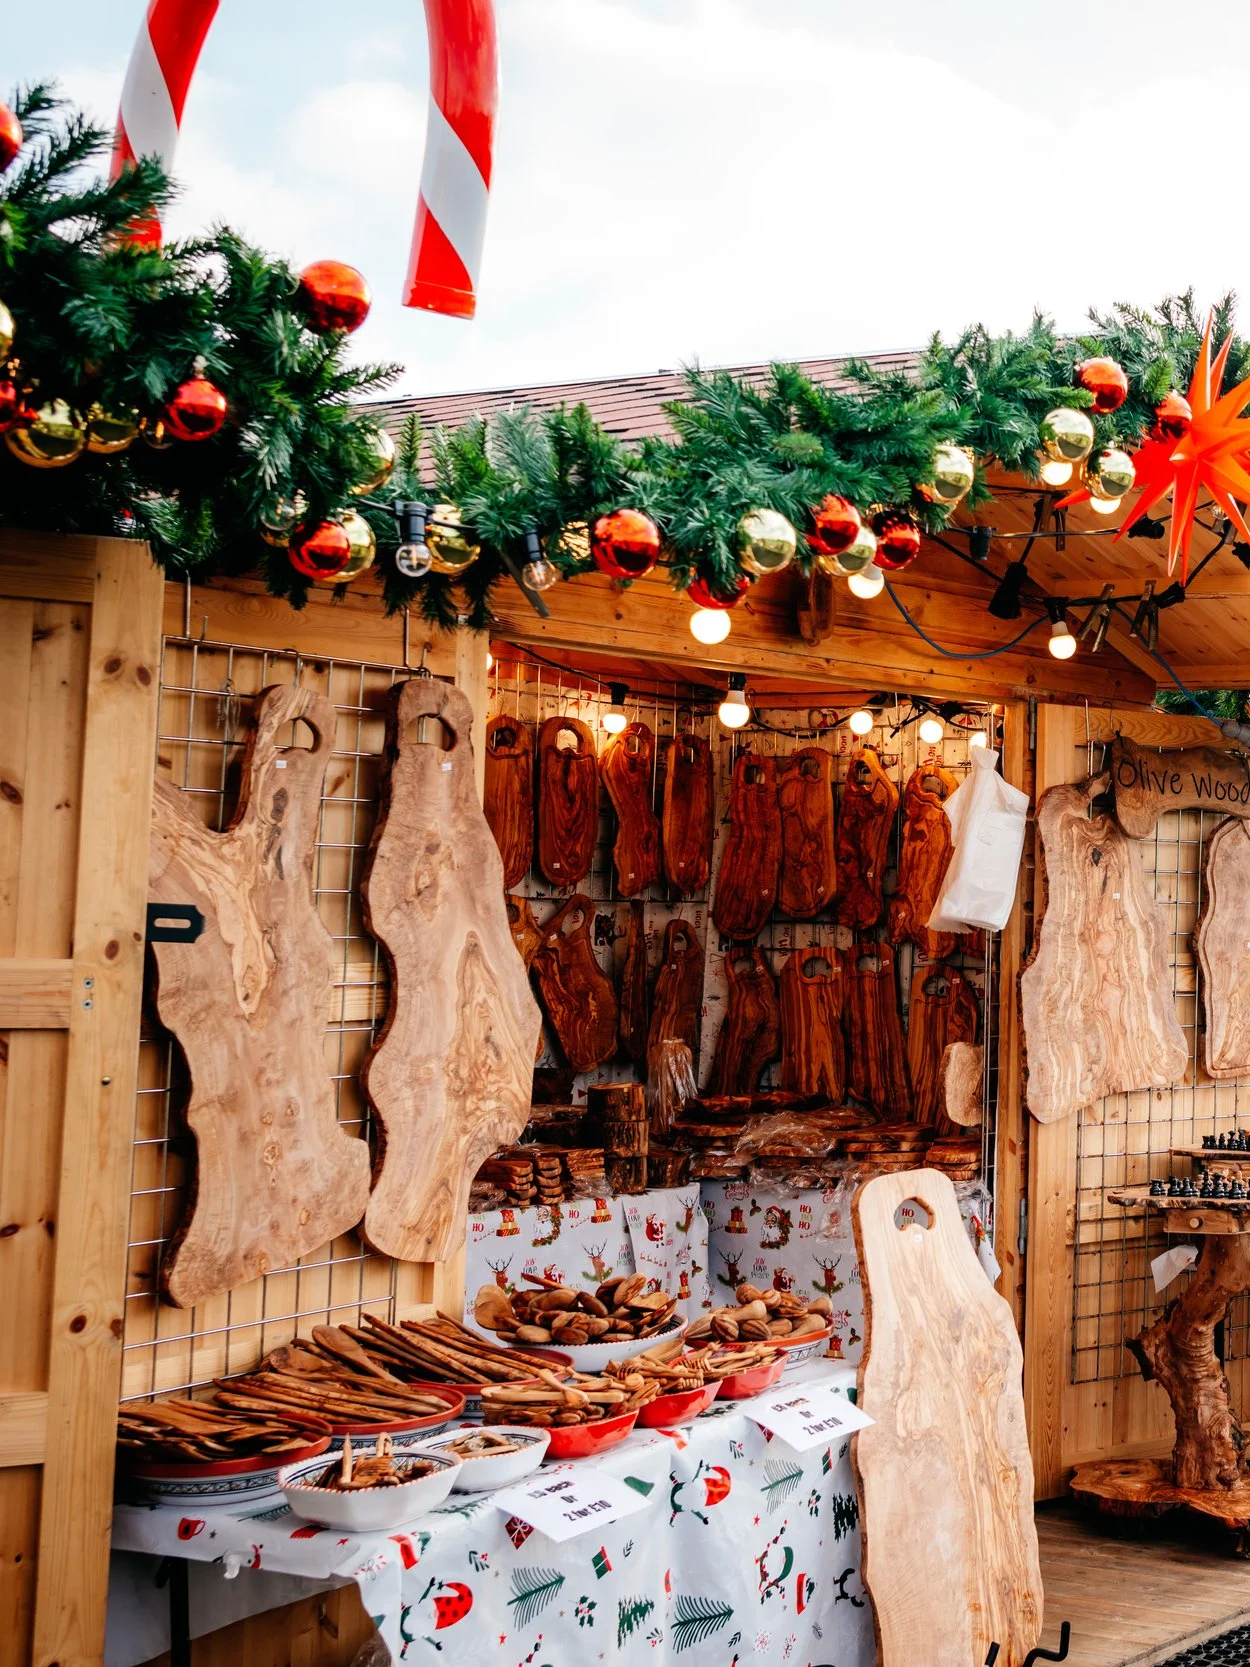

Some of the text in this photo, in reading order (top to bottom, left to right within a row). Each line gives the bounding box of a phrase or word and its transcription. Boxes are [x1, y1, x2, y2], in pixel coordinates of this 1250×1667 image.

[1117, 759, 1184, 795] Olive
[568, 1209, 580, 1219] HO
[800, 1204, 812, 1214] HO
[901, 1208, 915, 1217] HO
[472, 1222, 485, 1232] HO
[798, 1220, 811, 1230] HO
[802, 1417, 844, 1436] 2 for £10
[563, 1500, 613, 1522] 2 for £10
